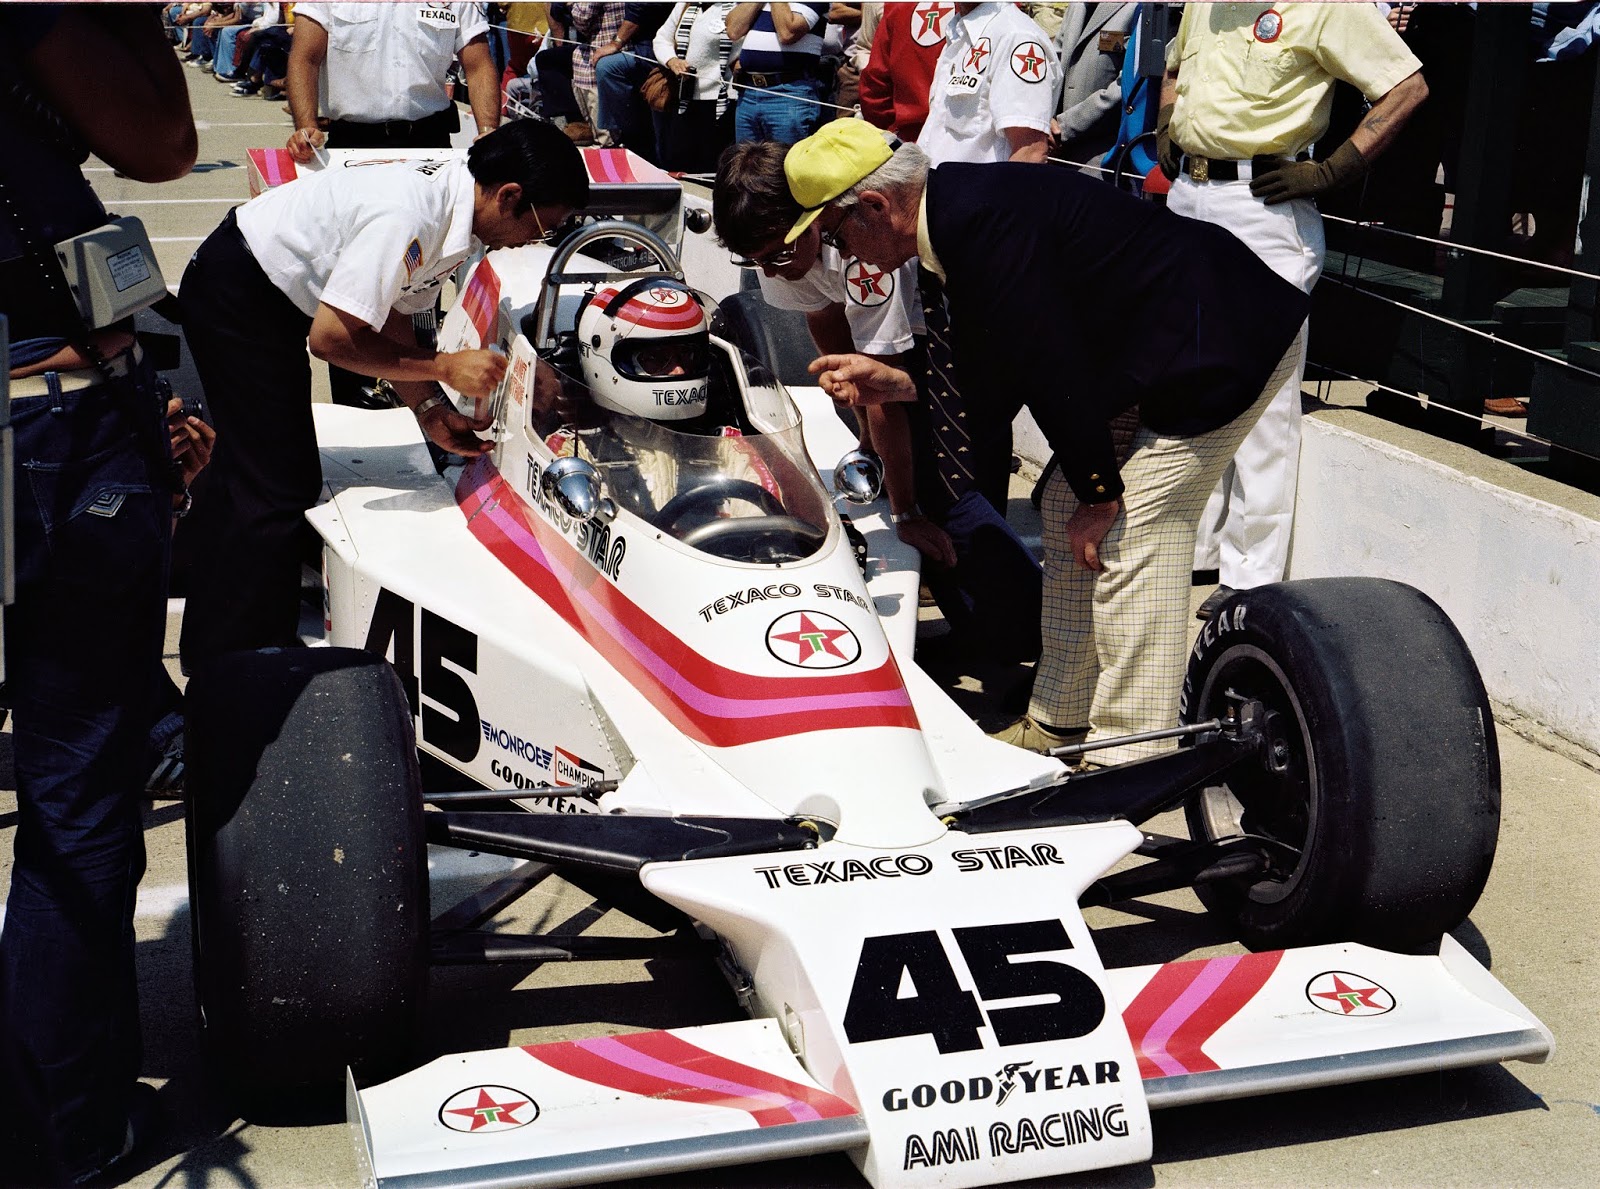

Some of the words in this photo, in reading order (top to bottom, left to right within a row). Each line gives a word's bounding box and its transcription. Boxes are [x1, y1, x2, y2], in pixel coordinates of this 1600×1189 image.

[420, 10, 456, 23] TEXACO
[927, 12, 938, 29] T
[1026, 58, 1036, 71] T
[861, 278, 873, 294] T
[652, 384, 707, 406] TEXAC
[698, 583, 802, 623] TEXACO
[813, 583, 872, 615] STAR
[800, 633, 826, 652] T
[363, 586, 482, 763] 45
[490, 727, 544, 768] MONROE
[557, 760, 597, 788] CHAMPIO
[753, 854, 933, 889] TEXACO
[951, 842, 1066, 873] STAR
[843, 918, 1106, 1055] 45
[1338, 992, 1361, 1008] T
[475, 1107, 502, 1123] T
[903, 1126, 980, 1171] AMI
[989, 1103, 1130, 1158] RACING
